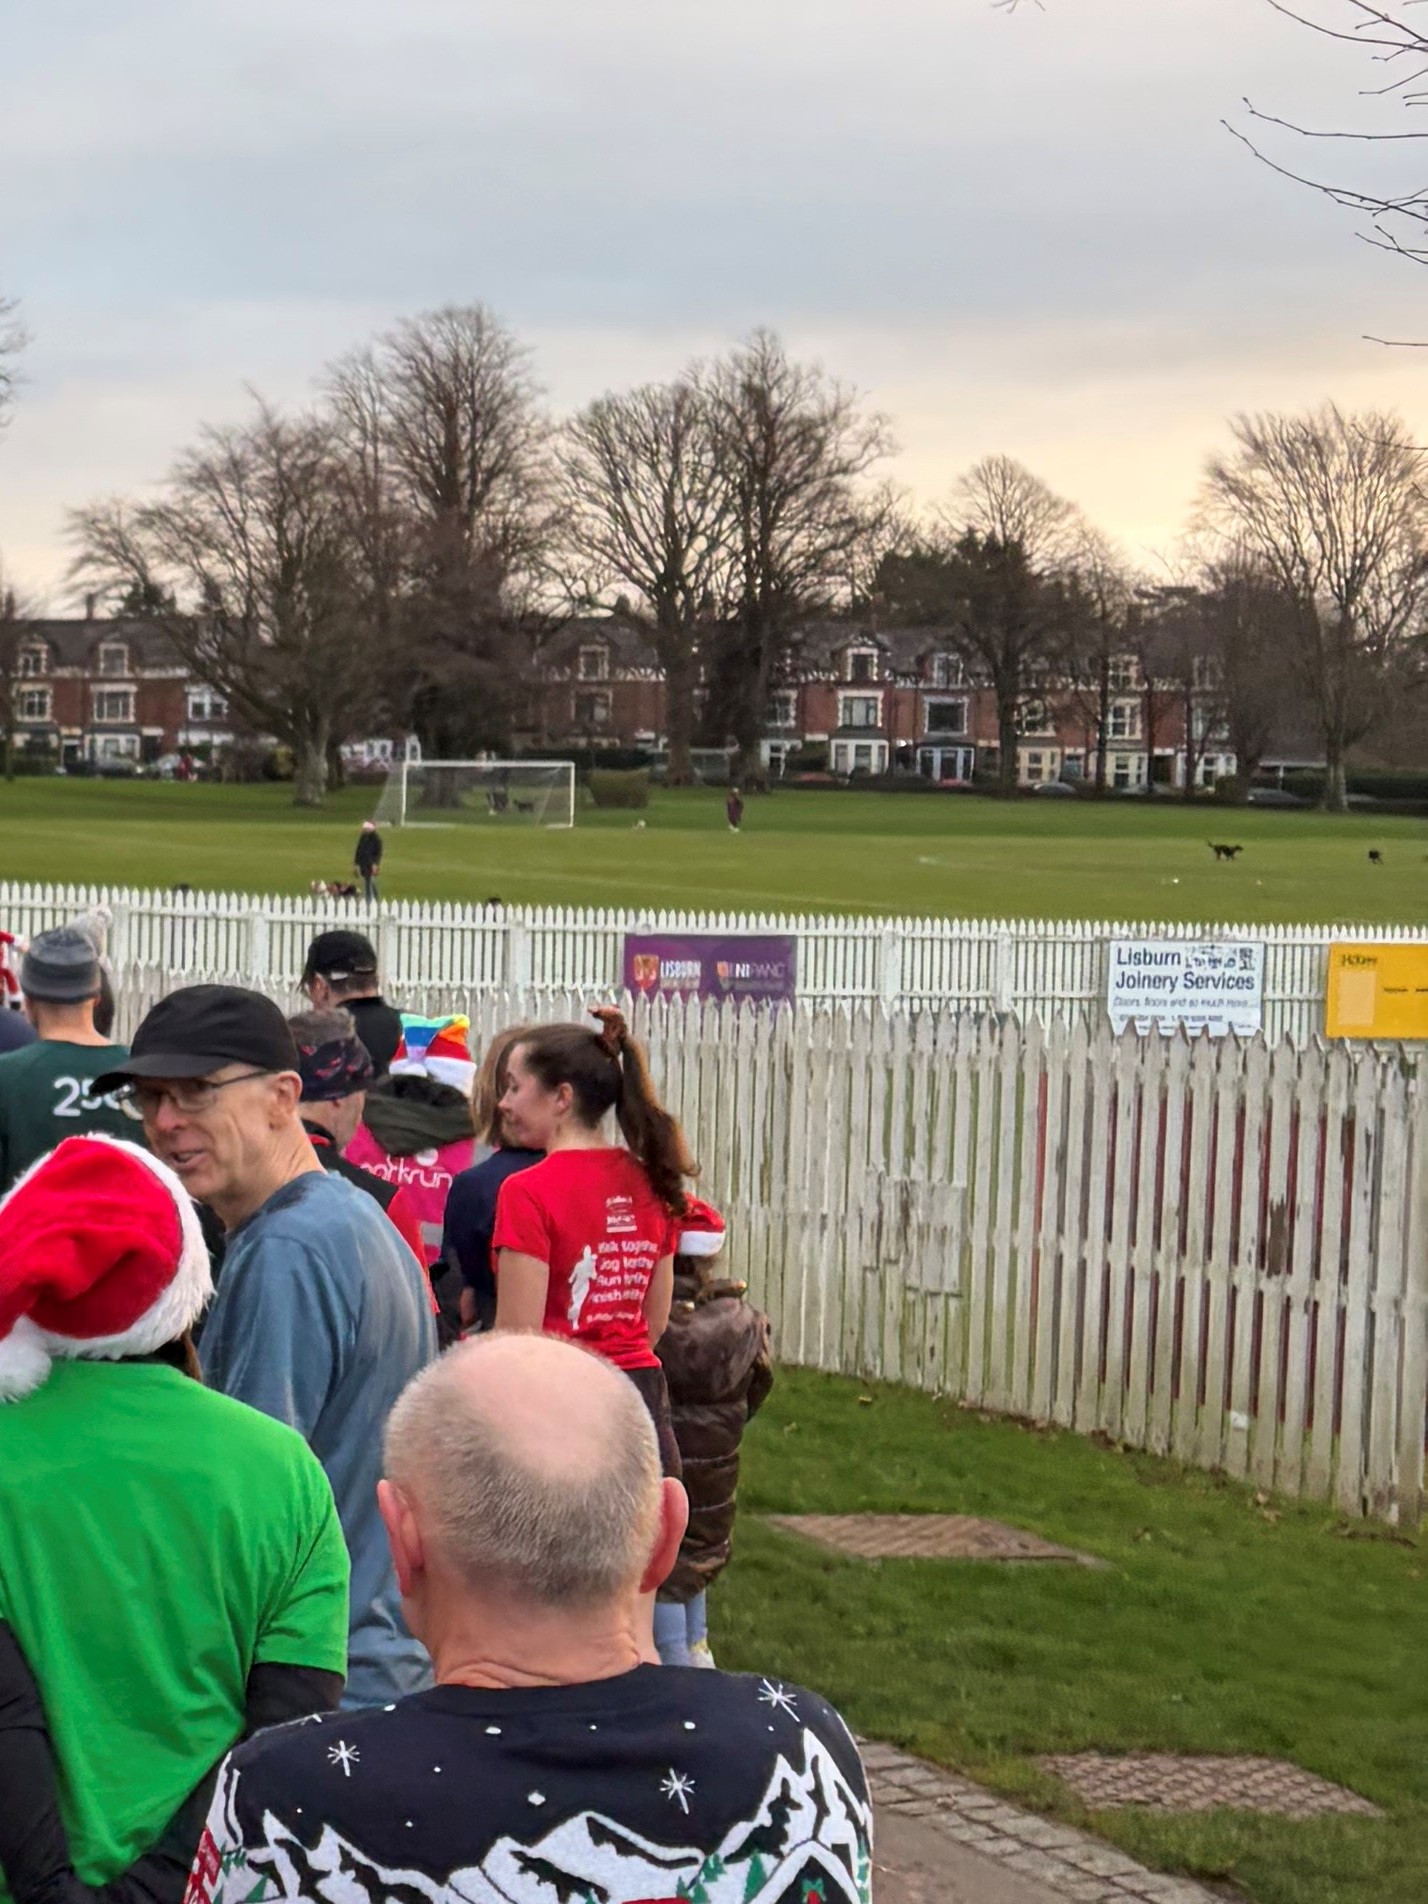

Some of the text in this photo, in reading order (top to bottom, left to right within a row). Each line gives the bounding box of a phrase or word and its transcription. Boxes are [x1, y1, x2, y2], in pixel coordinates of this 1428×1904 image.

[1116, 947, 1181, 966] Lisburn
[1115, 970, 1255, 994] Joinery Services
